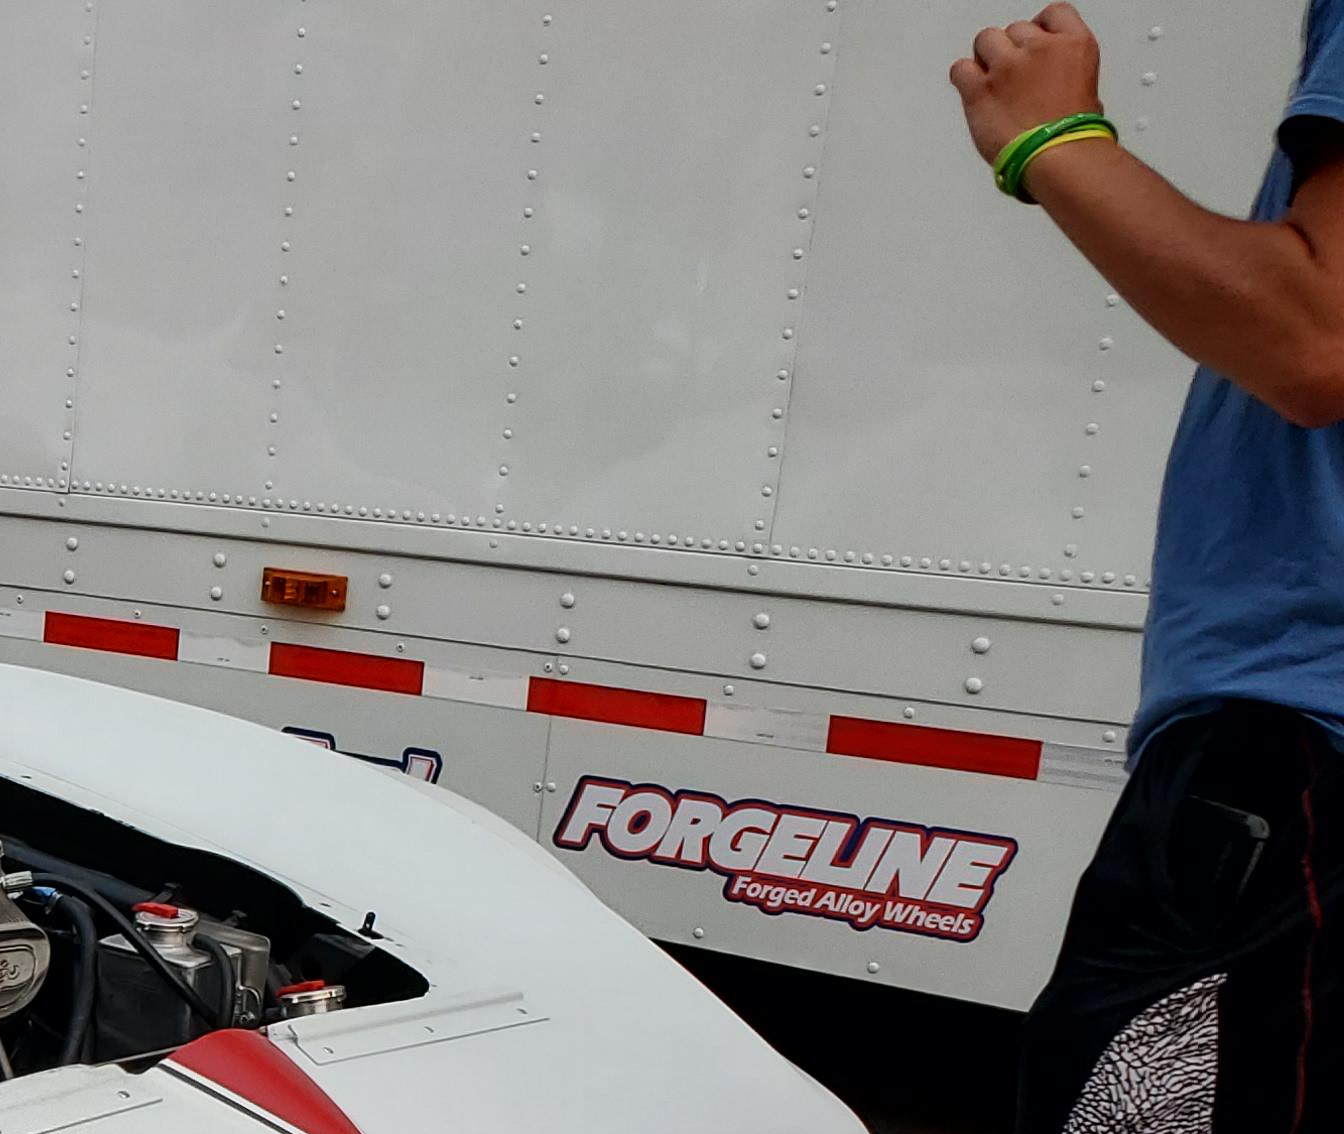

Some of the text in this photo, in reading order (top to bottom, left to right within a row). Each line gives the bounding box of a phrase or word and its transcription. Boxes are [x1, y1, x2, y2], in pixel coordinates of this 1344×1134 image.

[559, 781, 1010, 909] FORGELINE
[732, 876, 977, 935] Forged Alloy Wheels
